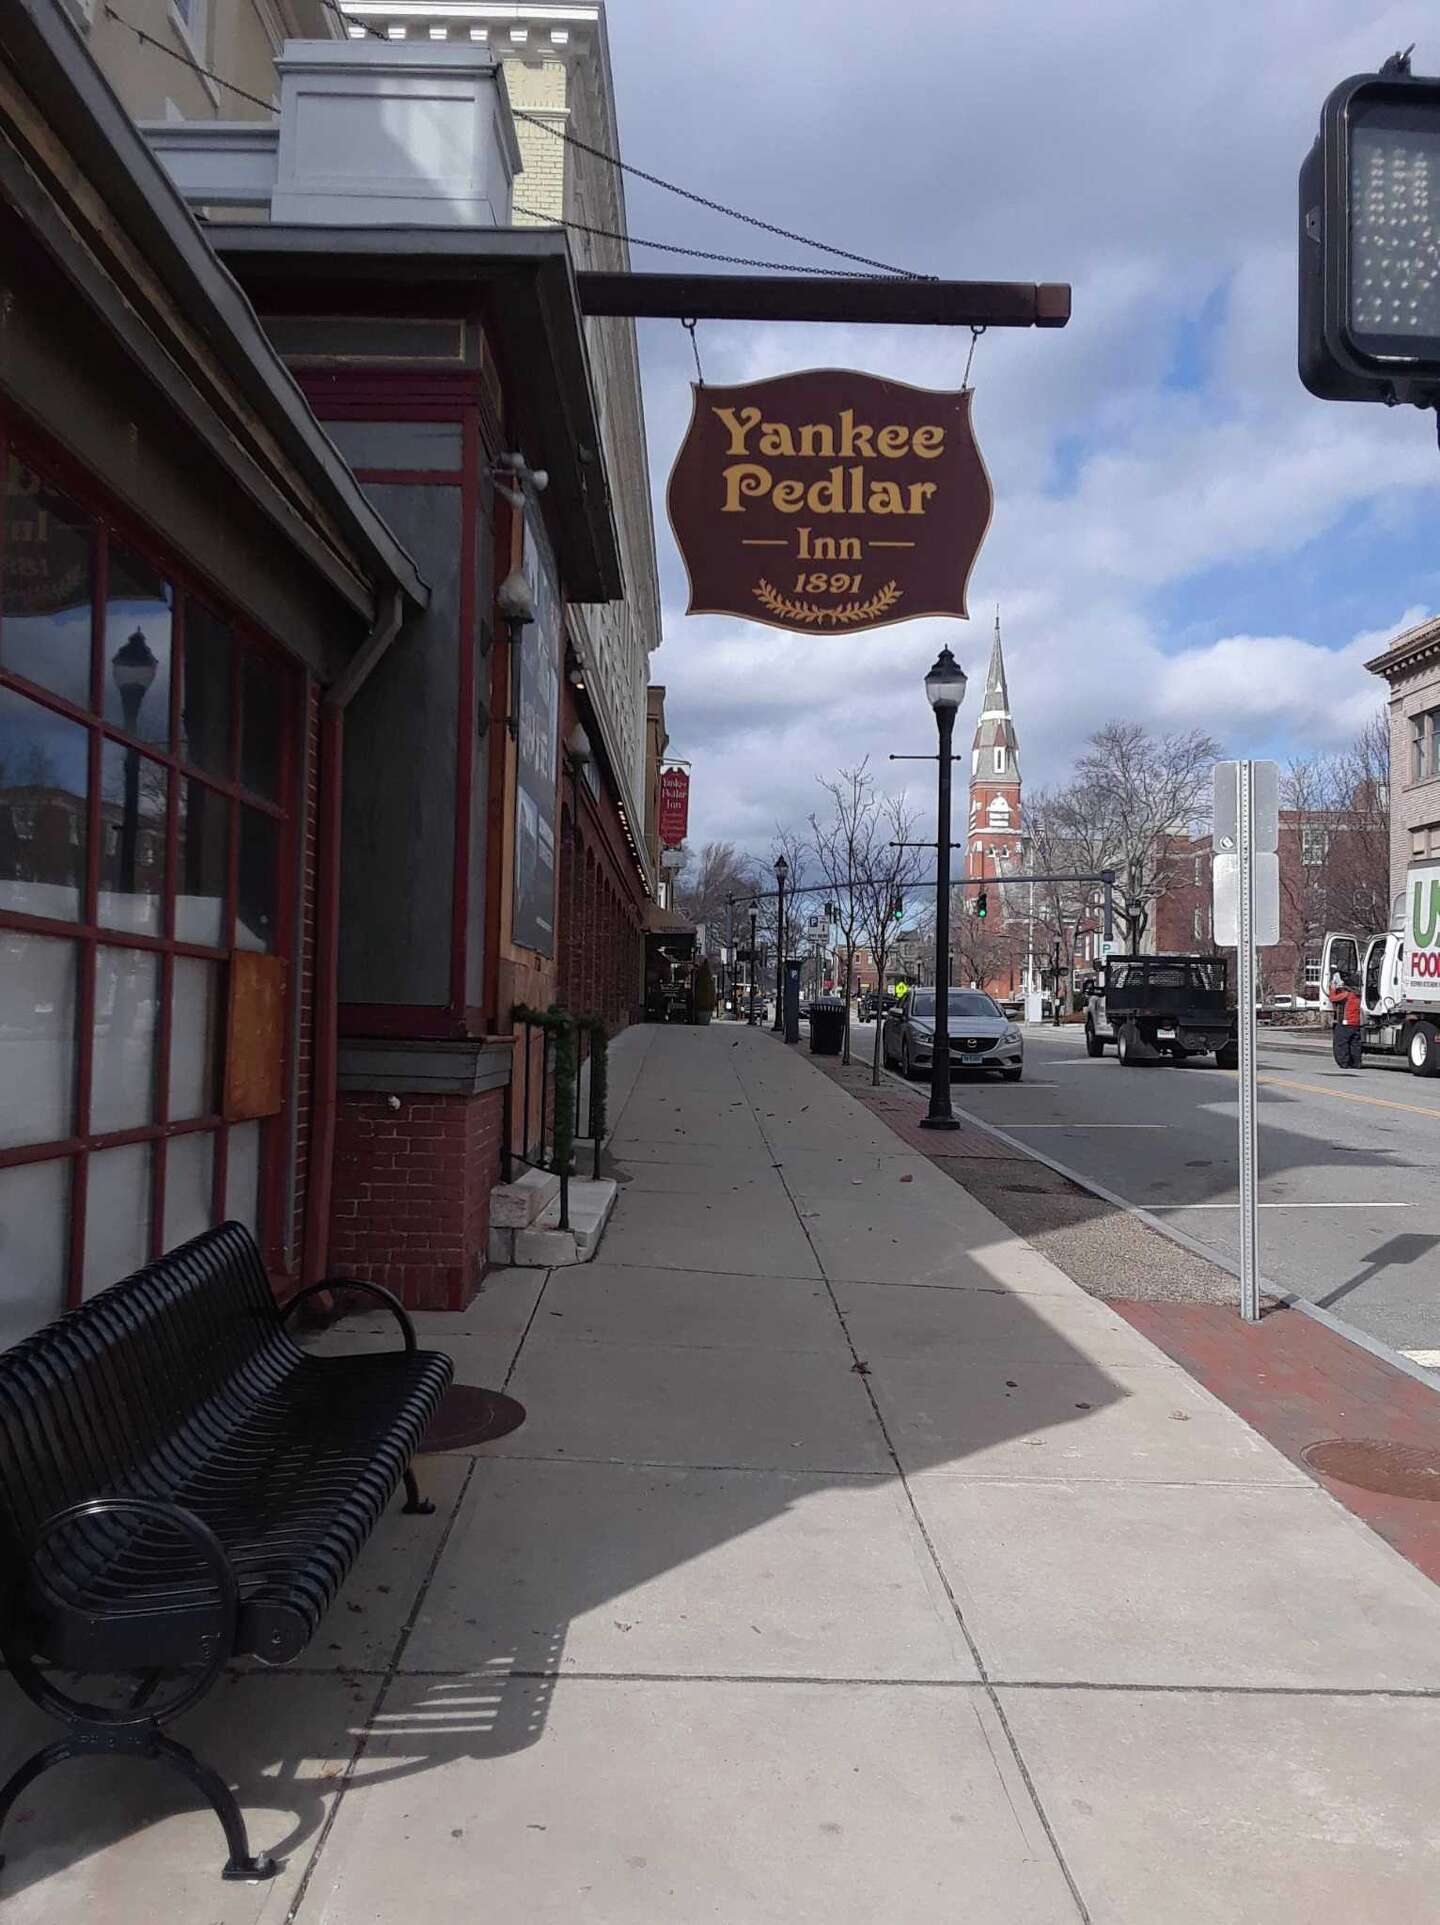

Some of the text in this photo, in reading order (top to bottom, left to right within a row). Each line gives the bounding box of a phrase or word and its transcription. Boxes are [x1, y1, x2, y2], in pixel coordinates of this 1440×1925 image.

[712, 406, 946, 459] Yankee
[720, 463, 938, 515] Pedlar
[796, 527, 863, 560] Inn
[793, 572, 863, 594] 1891
[1413, 880, 1440, 948] U
